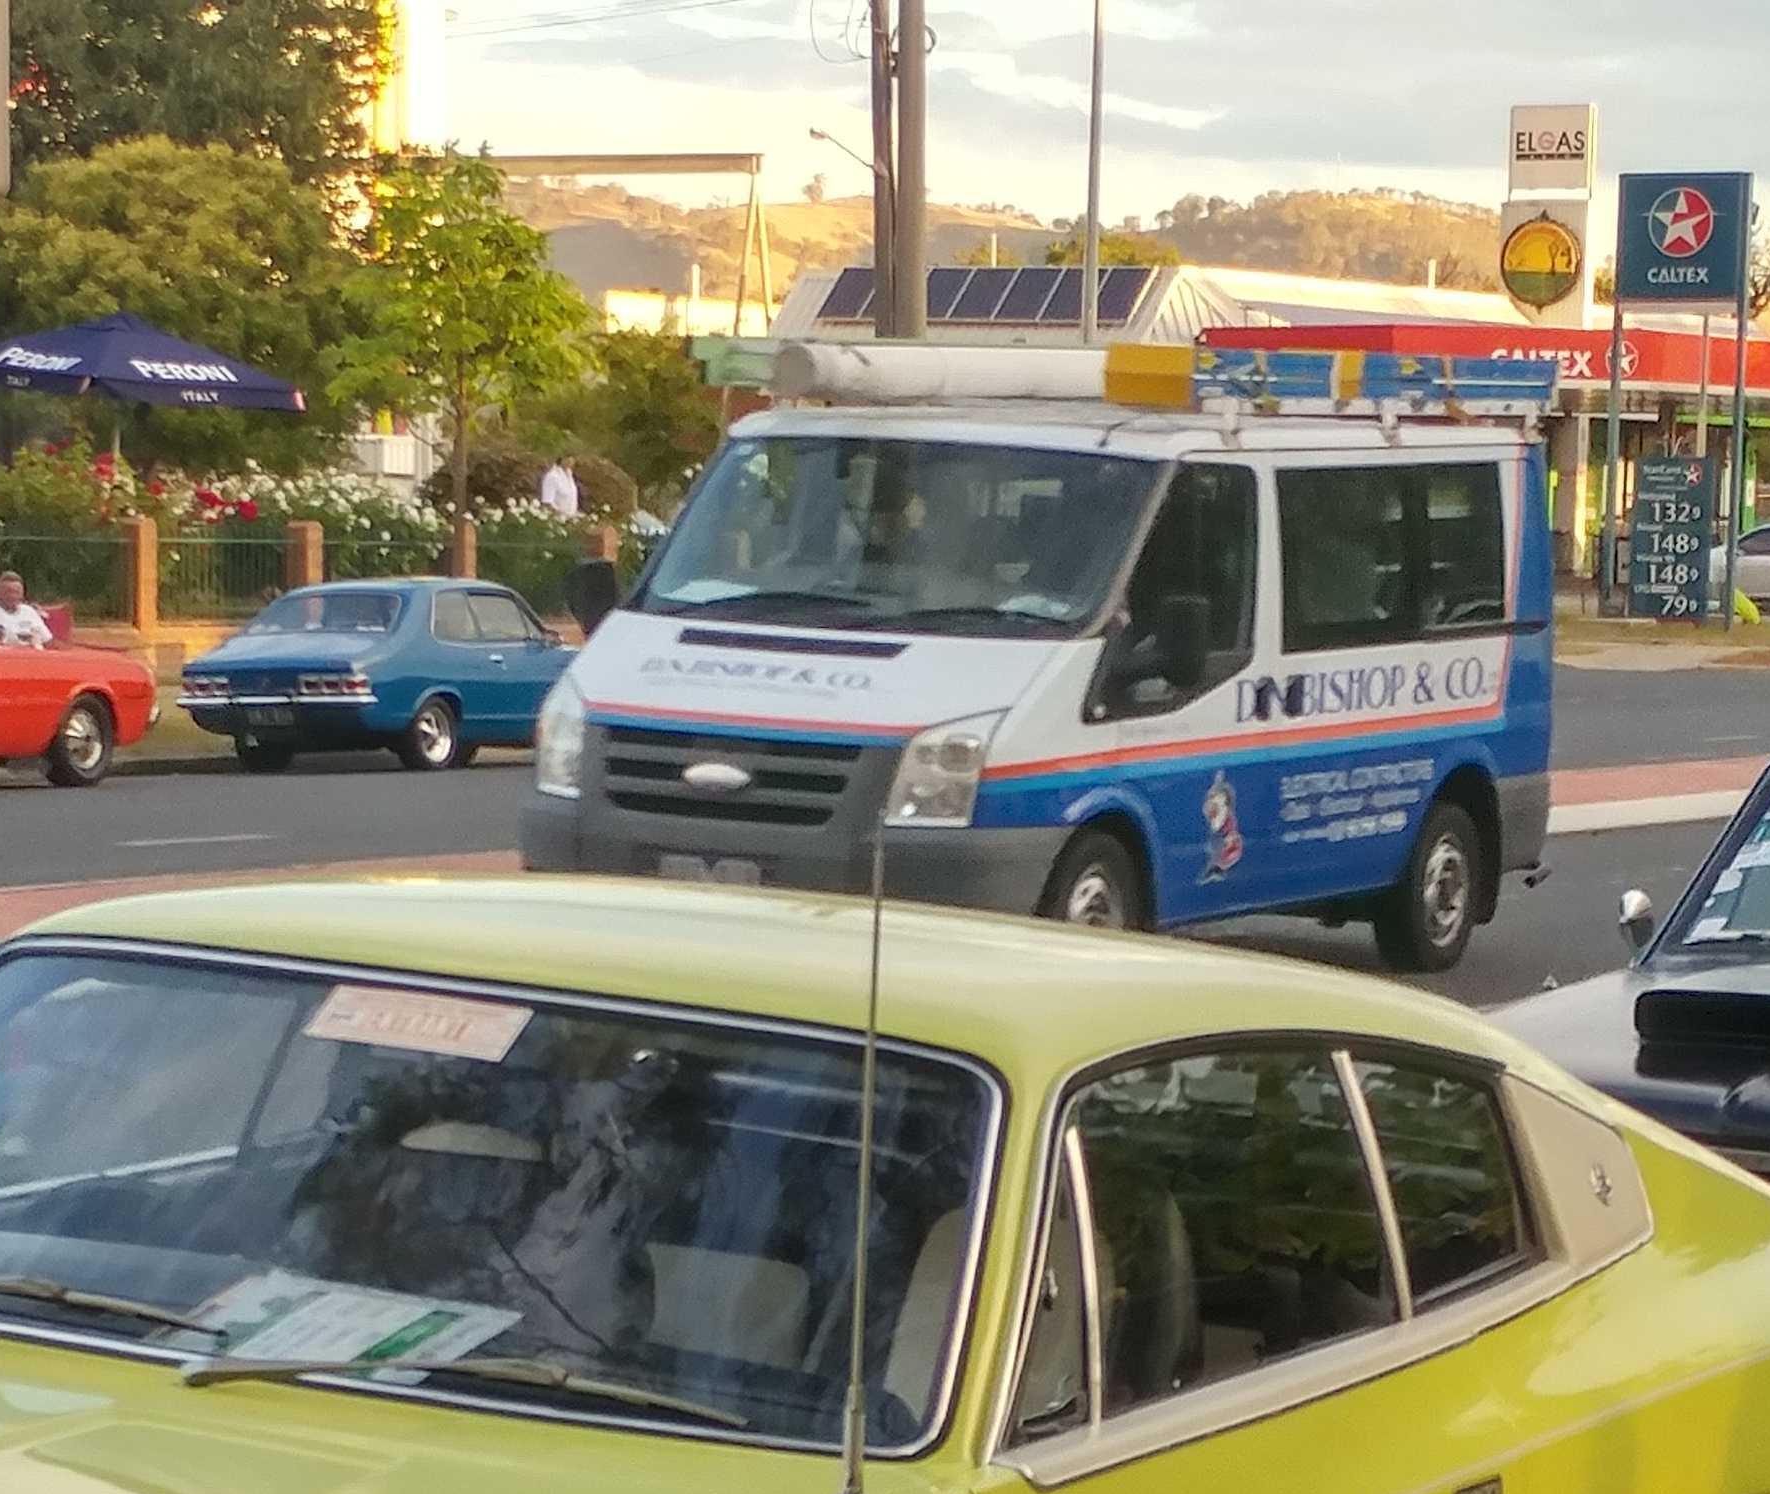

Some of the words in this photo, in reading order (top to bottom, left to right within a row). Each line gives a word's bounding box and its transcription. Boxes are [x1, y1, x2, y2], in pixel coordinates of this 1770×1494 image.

[1516, 130, 1585, 152] ELGAS
[1647, 266, 1709, 285] CALTEX
[129, 359, 239, 383] PERONI
[181, 390, 219, 403] ITALY
[1413, 661, 1435, 703] &
